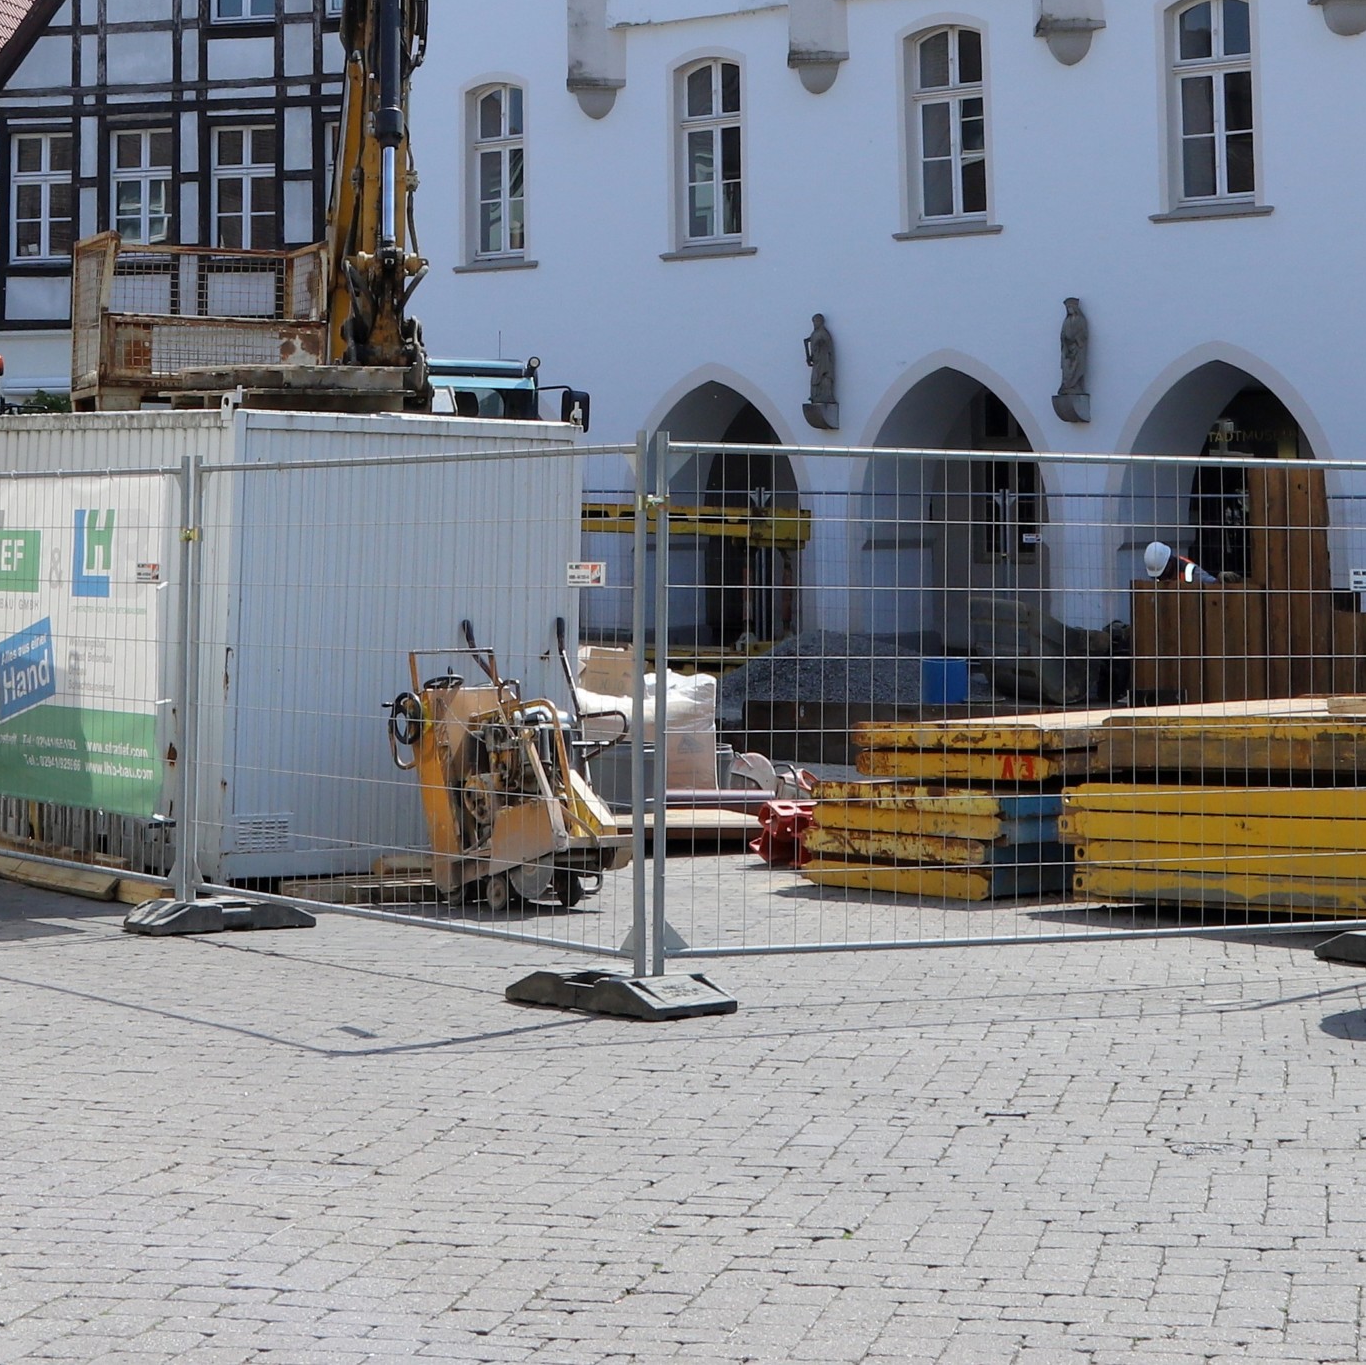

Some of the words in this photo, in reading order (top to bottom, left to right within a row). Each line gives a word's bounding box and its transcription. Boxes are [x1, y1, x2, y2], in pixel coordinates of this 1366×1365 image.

[18, 598, 40, 611] GMBH
[1, 647, 17, 666] Alles
[17, 642, 30, 657] aus
[30, 633, 48, 651] einer
[2, 648, 51, 705] Hand
